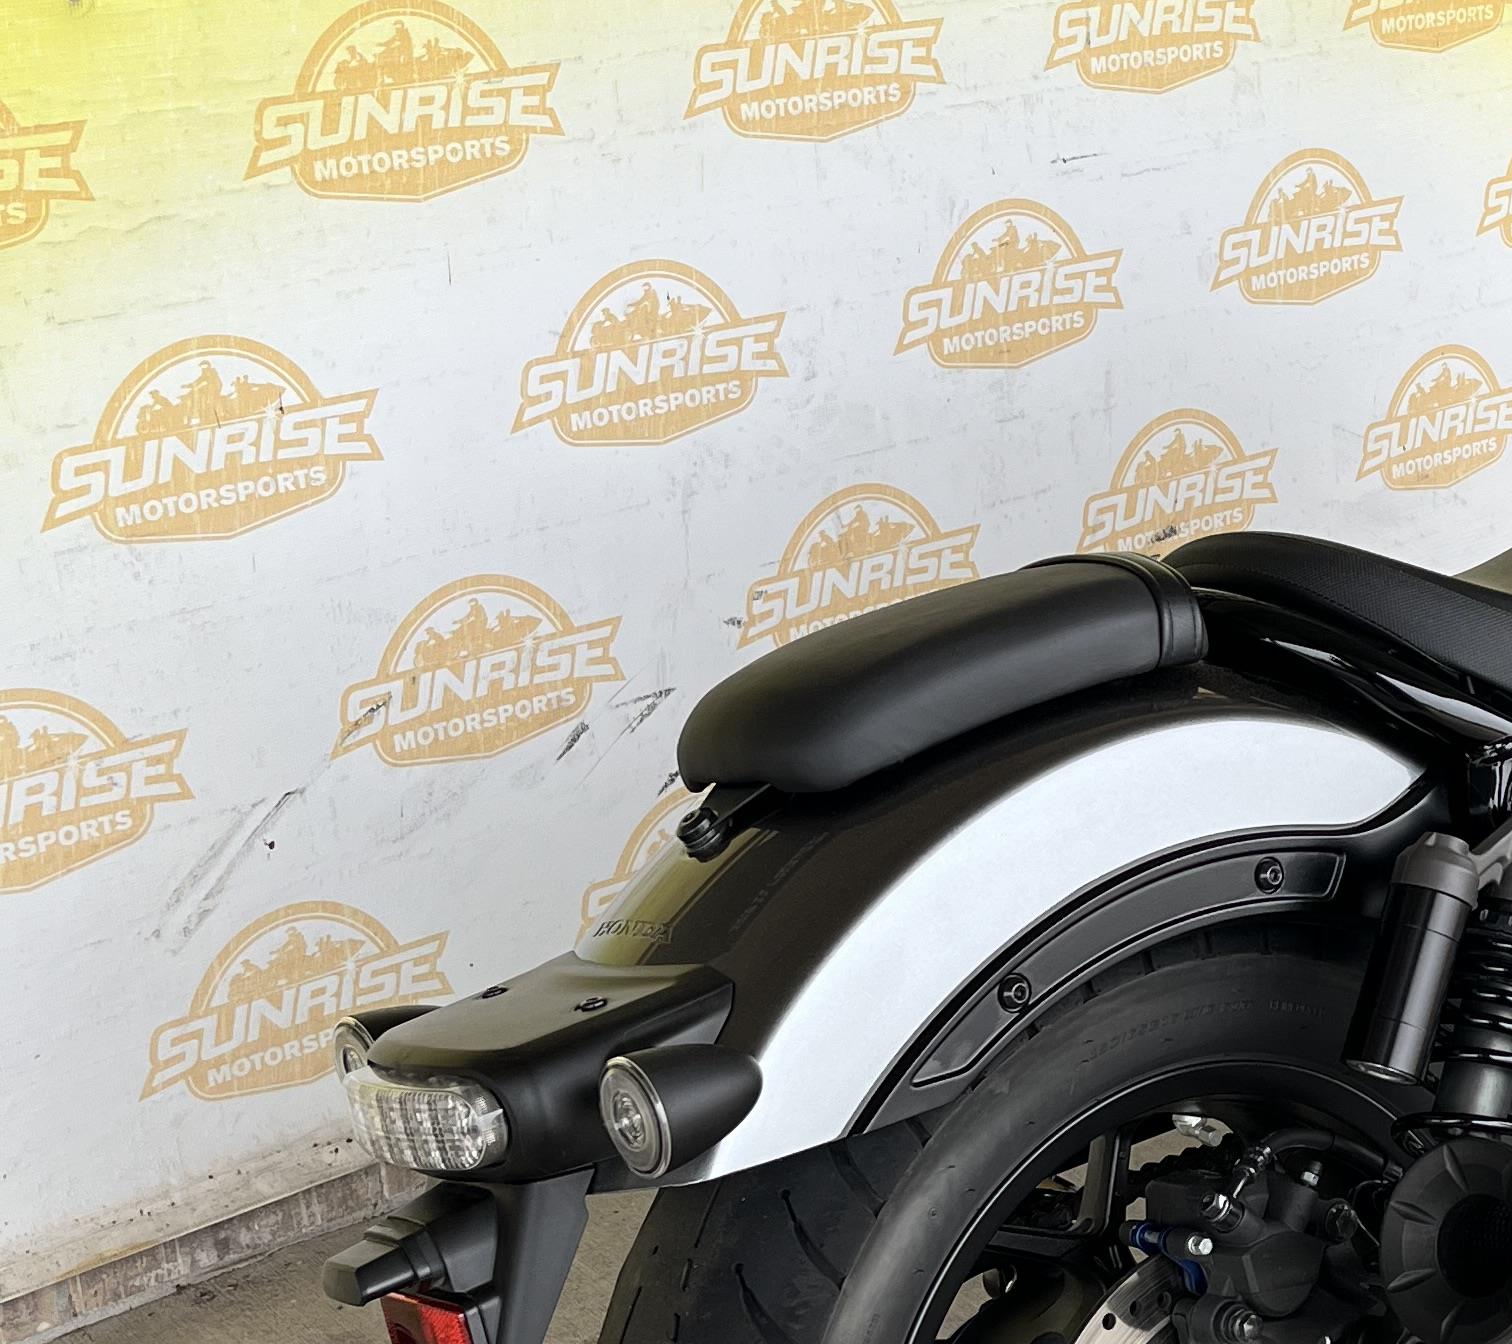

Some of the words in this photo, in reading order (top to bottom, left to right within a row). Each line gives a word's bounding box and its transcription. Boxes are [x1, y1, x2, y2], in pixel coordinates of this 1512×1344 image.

[1380, 4, 1495, 33] MOTORSPORTS
[695, 24, 940, 108] SUNRISE
[1090, 41, 1223, 75] MOTORSPORTS
[255, 64, 553, 169] SUNRISE
[740, 83, 901, 122] MOTORSPORTS
[313, 136, 511, 182] MOTORSPORTS
[1218, 201, 1400, 282] SUNRISE
[1251, 252, 1370, 291] MOTORSPORTS
[904, 254, 1121, 342] SUNRISE
[943, 310, 1085, 355] MOTORSPORTS
[522, 320, 783, 421] SUNRISE
[570, 381, 742, 433] MOTORSPORTS
[54, 398, 375, 519] SUNRISE
[1391, 436, 1498, 479] MOTORSPORTS
[115, 465, 326, 529] MOTORSPORTS
[1083, 451, 1275, 548] SUNRISE
[748, 534, 975, 638] SUNRISE
[339, 627, 618, 746] SUNRISE
[393, 688, 576, 754] MOTORSPORTS
[7, 739, 182, 825] RISE
[0, 810, 133, 864] RSPORTS
[593, 918, 674, 945] HONDA
[154, 939, 448, 1097] SUNRISE
